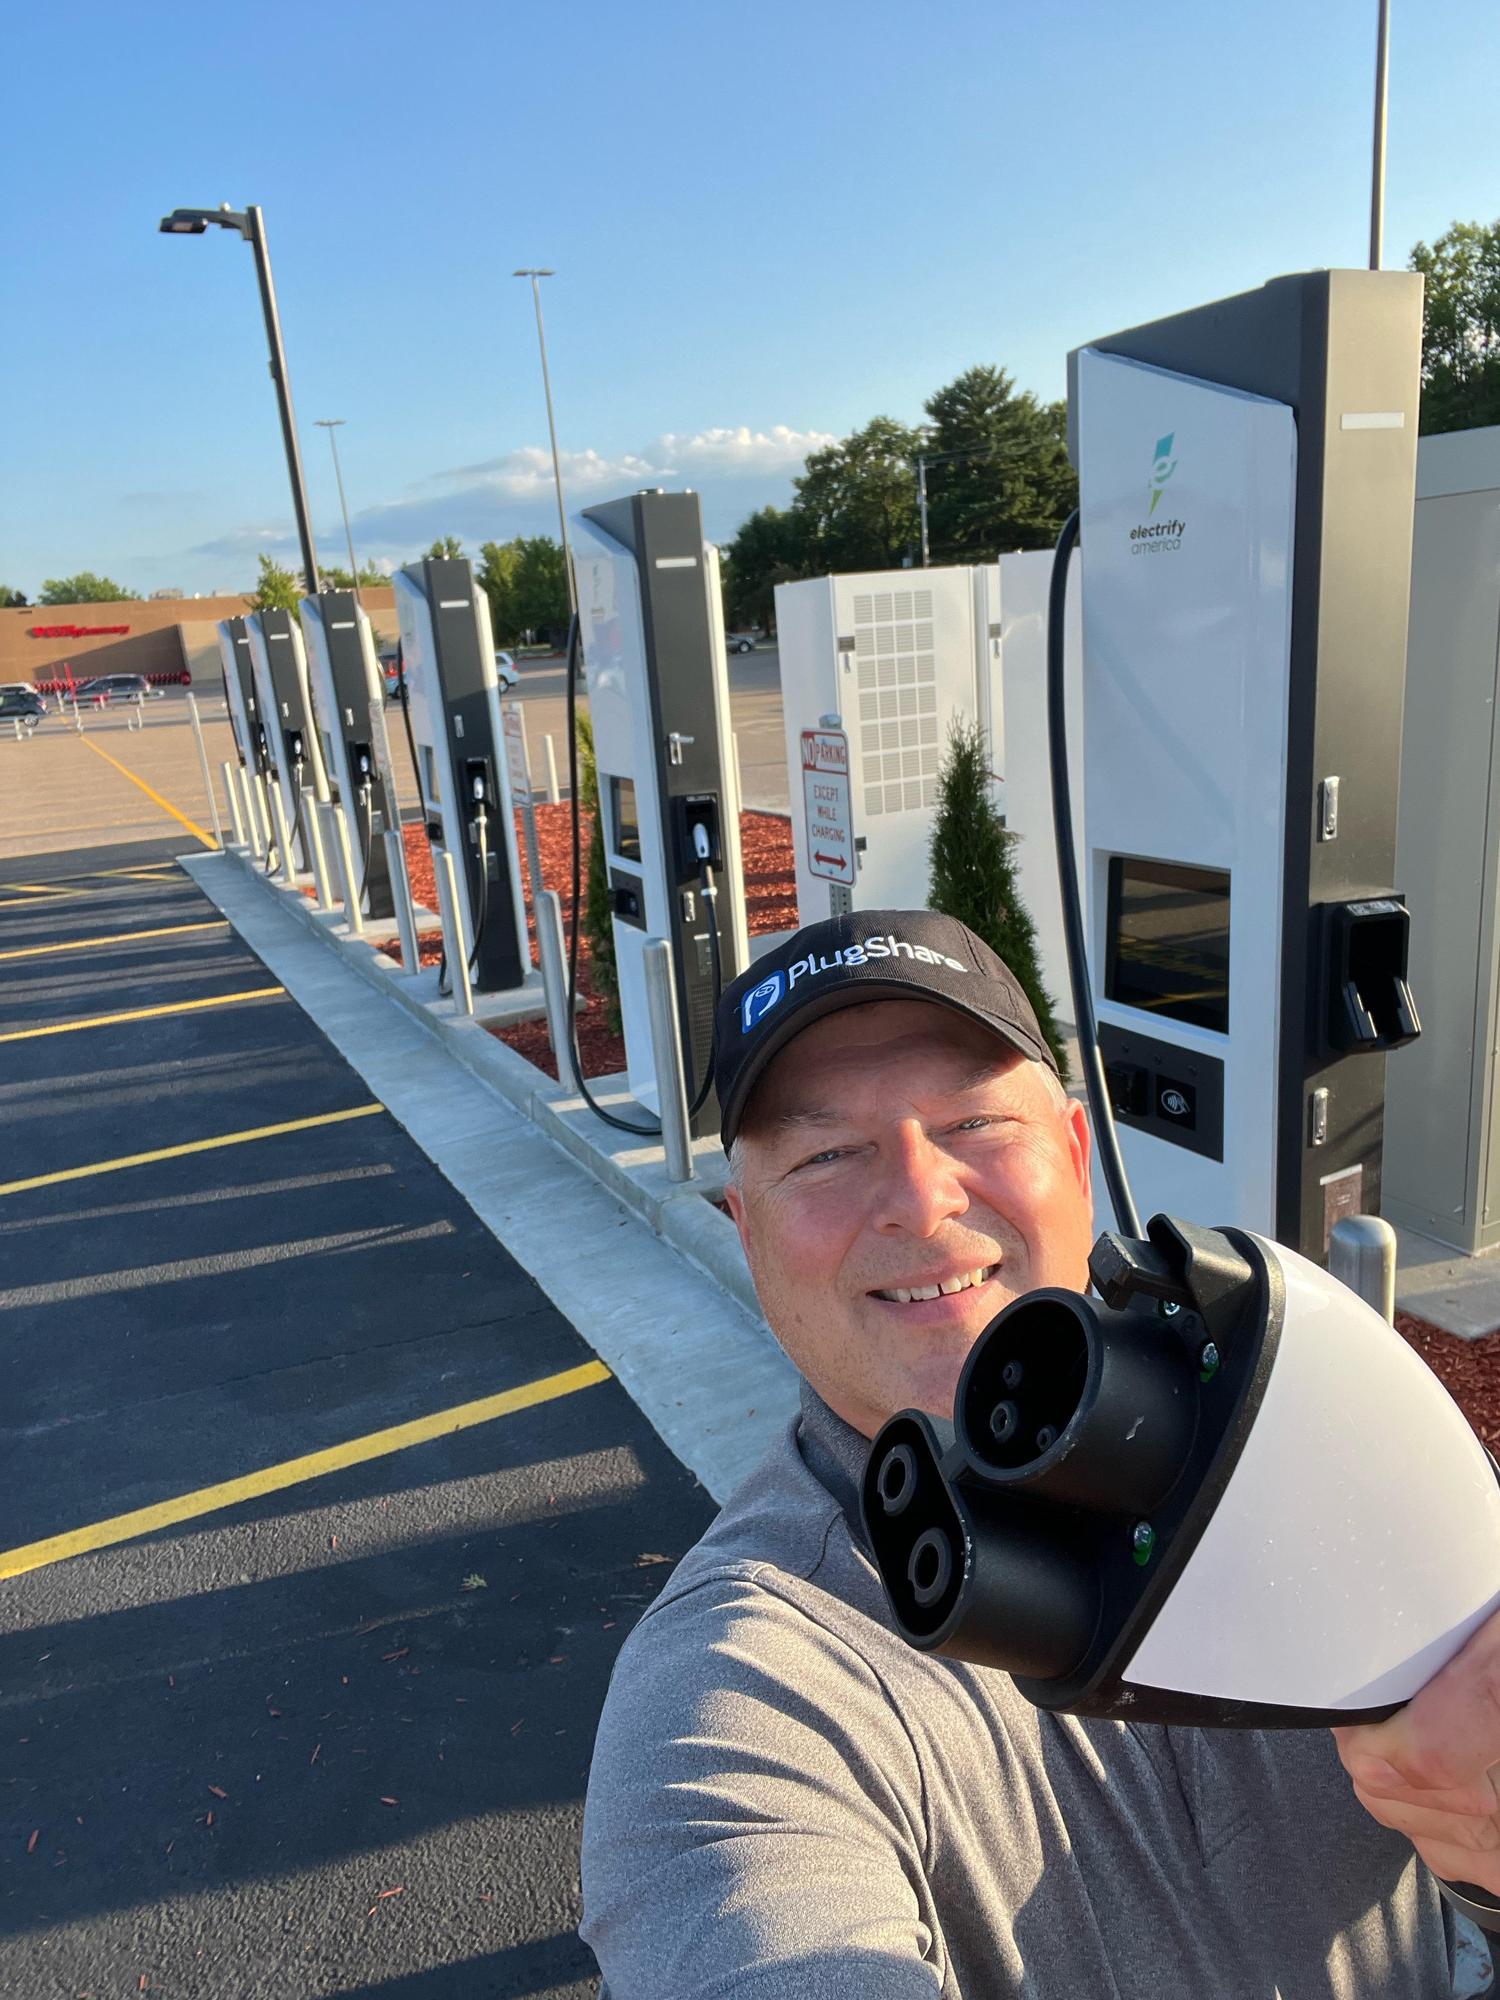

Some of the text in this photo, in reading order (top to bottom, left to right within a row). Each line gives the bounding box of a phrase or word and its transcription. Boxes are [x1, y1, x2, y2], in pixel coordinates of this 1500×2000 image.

[1130, 519, 1186, 539] electrify
[1131, 537, 1182, 555] america
[802, 737, 846, 766] NO PARKING
[813, 784, 838, 802] EXCEPT
[816, 804, 837, 822] WHILE
[811, 823, 845, 843] CHARGING
[788, 935, 969, 991] PlugShare
